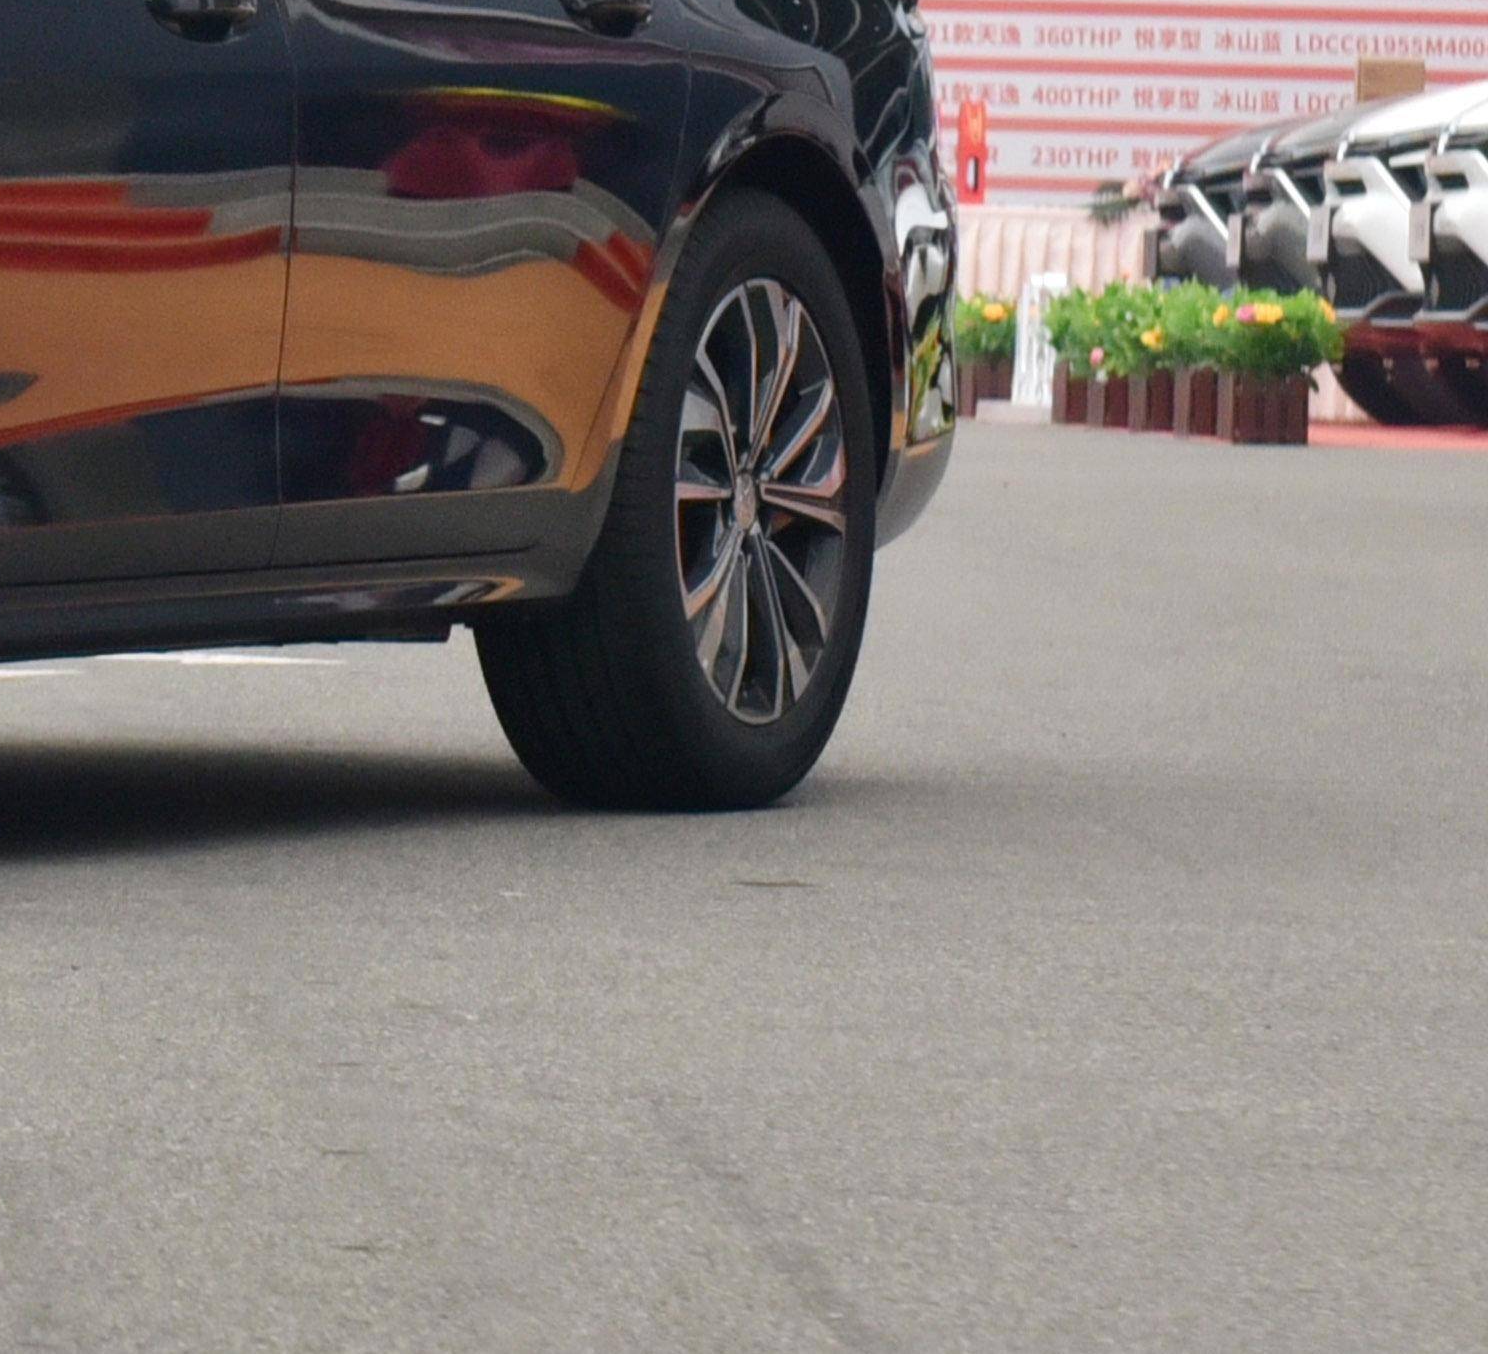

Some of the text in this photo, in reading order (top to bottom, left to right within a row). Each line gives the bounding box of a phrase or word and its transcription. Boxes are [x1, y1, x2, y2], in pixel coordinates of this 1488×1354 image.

[1034, 24, 1122, 48] 360THP
[1213, 28, 1282, 53] 冰山蓝
[1032, 84, 1120, 108] 400THP
[1032, 147, 1119, 169] 230THP
